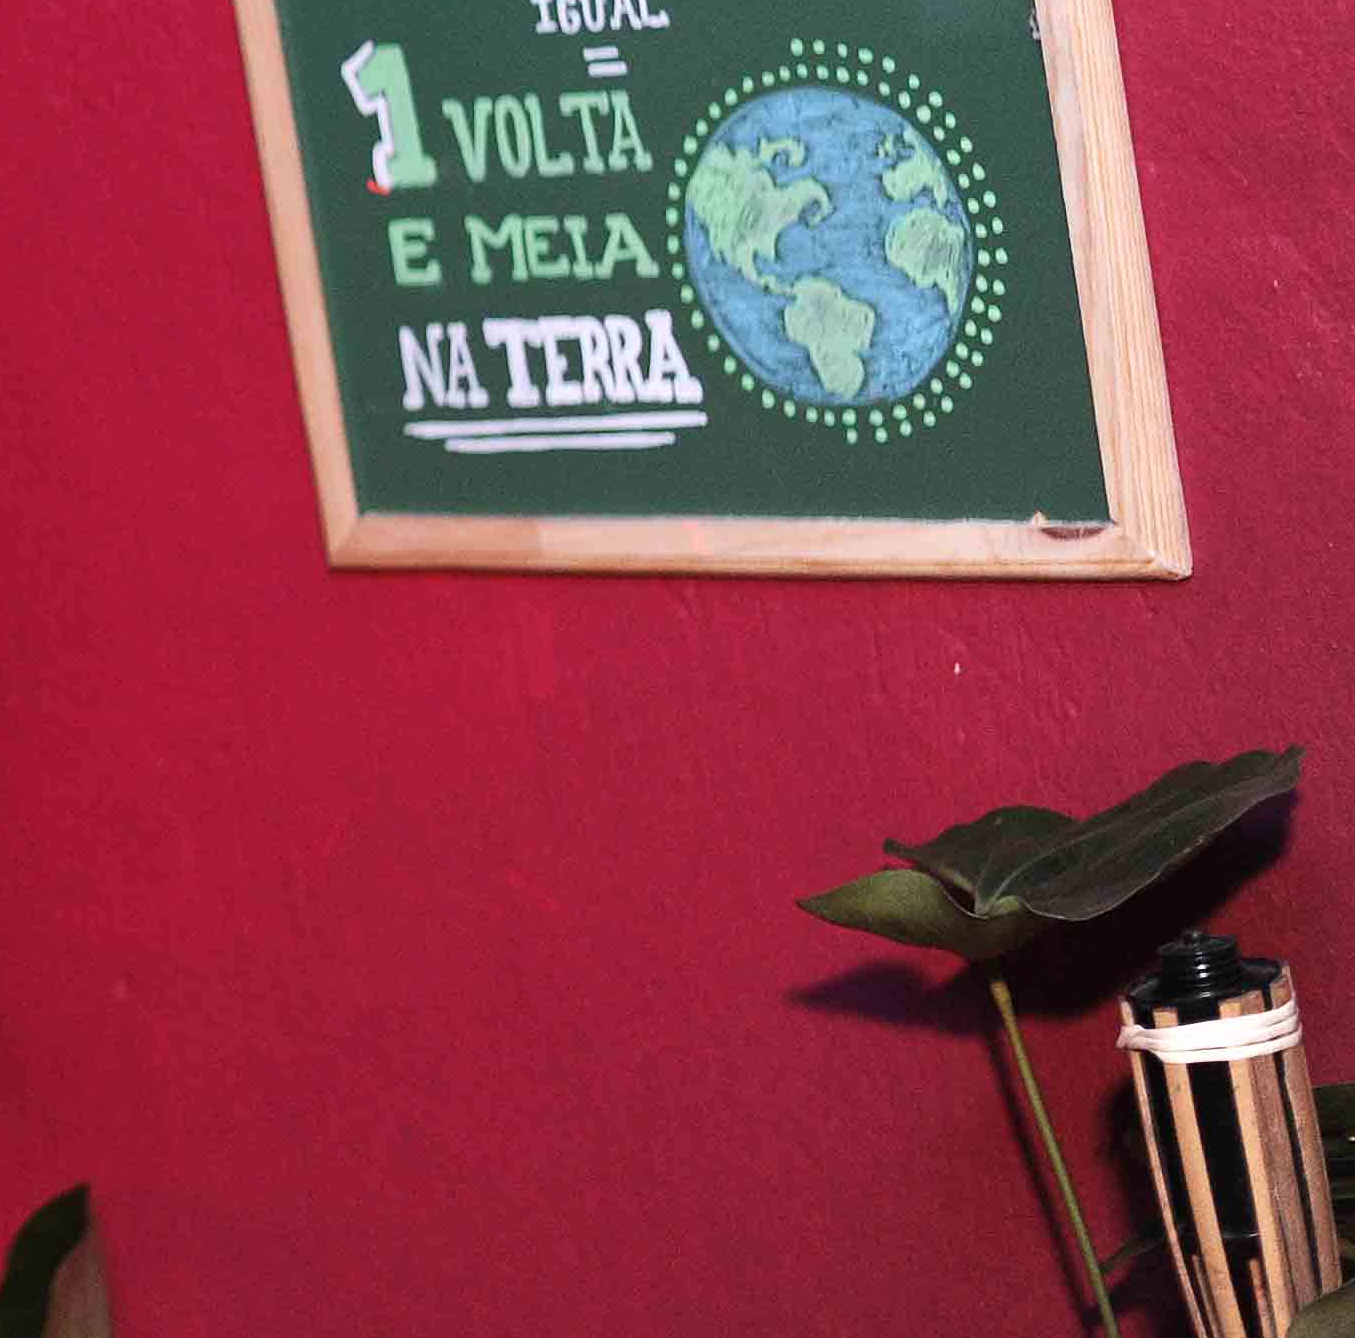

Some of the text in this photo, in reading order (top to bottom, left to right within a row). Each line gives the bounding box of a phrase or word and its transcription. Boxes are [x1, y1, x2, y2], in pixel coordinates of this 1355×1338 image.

[340, 37, 655, 193] 1 VOLTA
[387, 212, 661, 287] E MEIA
[398, 308, 705, 412] NA TERRA
